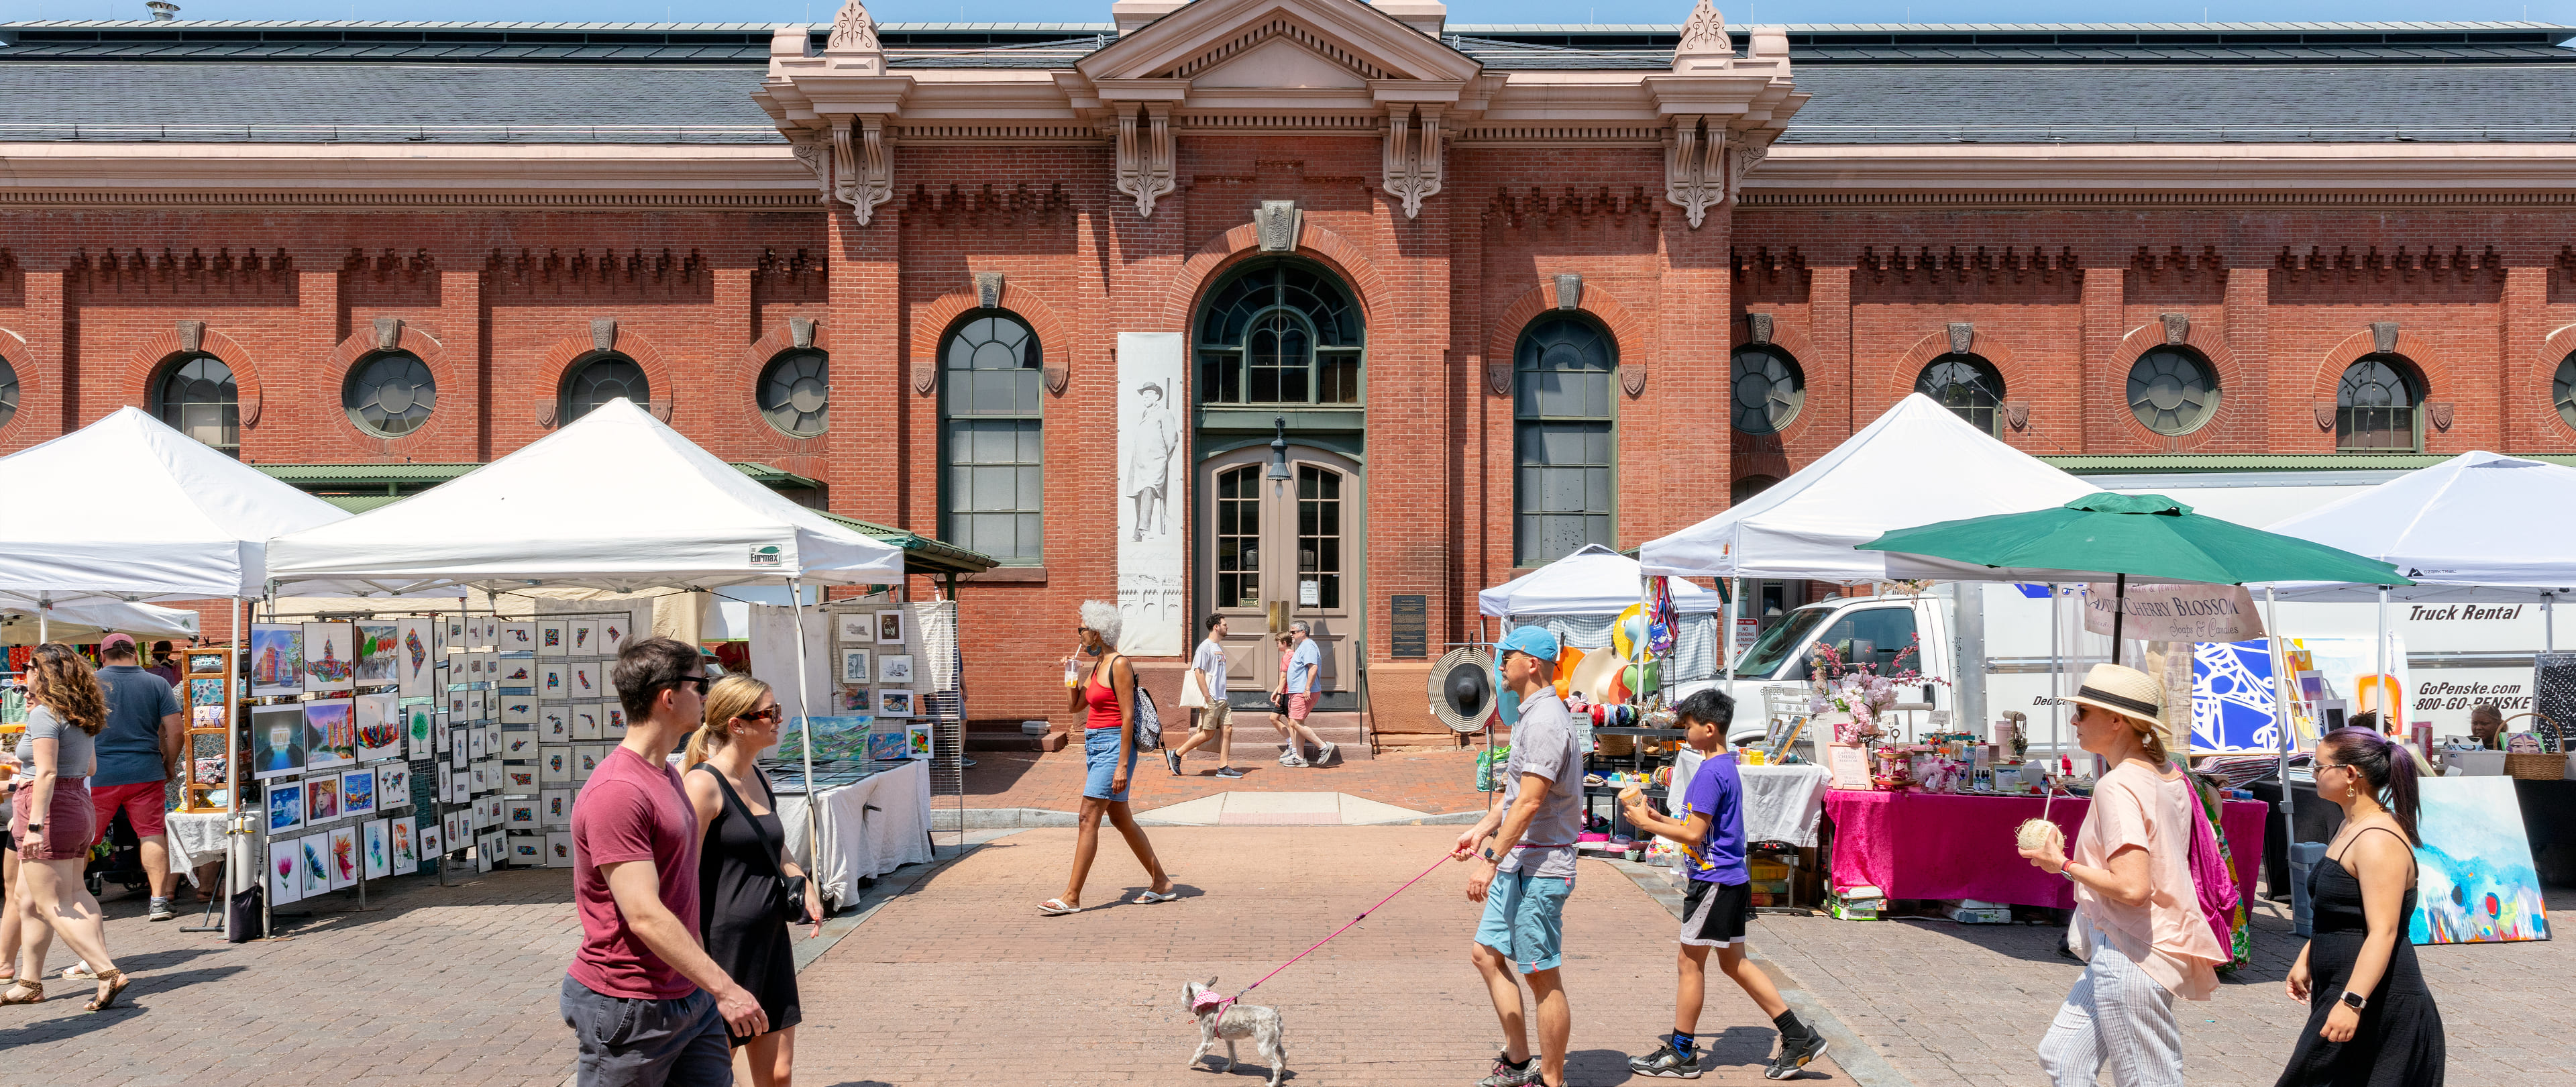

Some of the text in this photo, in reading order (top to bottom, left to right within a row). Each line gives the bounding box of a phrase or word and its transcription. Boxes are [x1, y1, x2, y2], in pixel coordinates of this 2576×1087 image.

[751, 553, 778, 562] Eurmax
[2124, 597, 2173, 617] CHERRY
[2171, 597, 2241, 617] BLOSSOM
[2410, 605, 2523, 621] Truck Rental
[2169, 618, 2239, 637] Soaps & Candles
[2419, 682, 2522, 695] GoPenske.com
